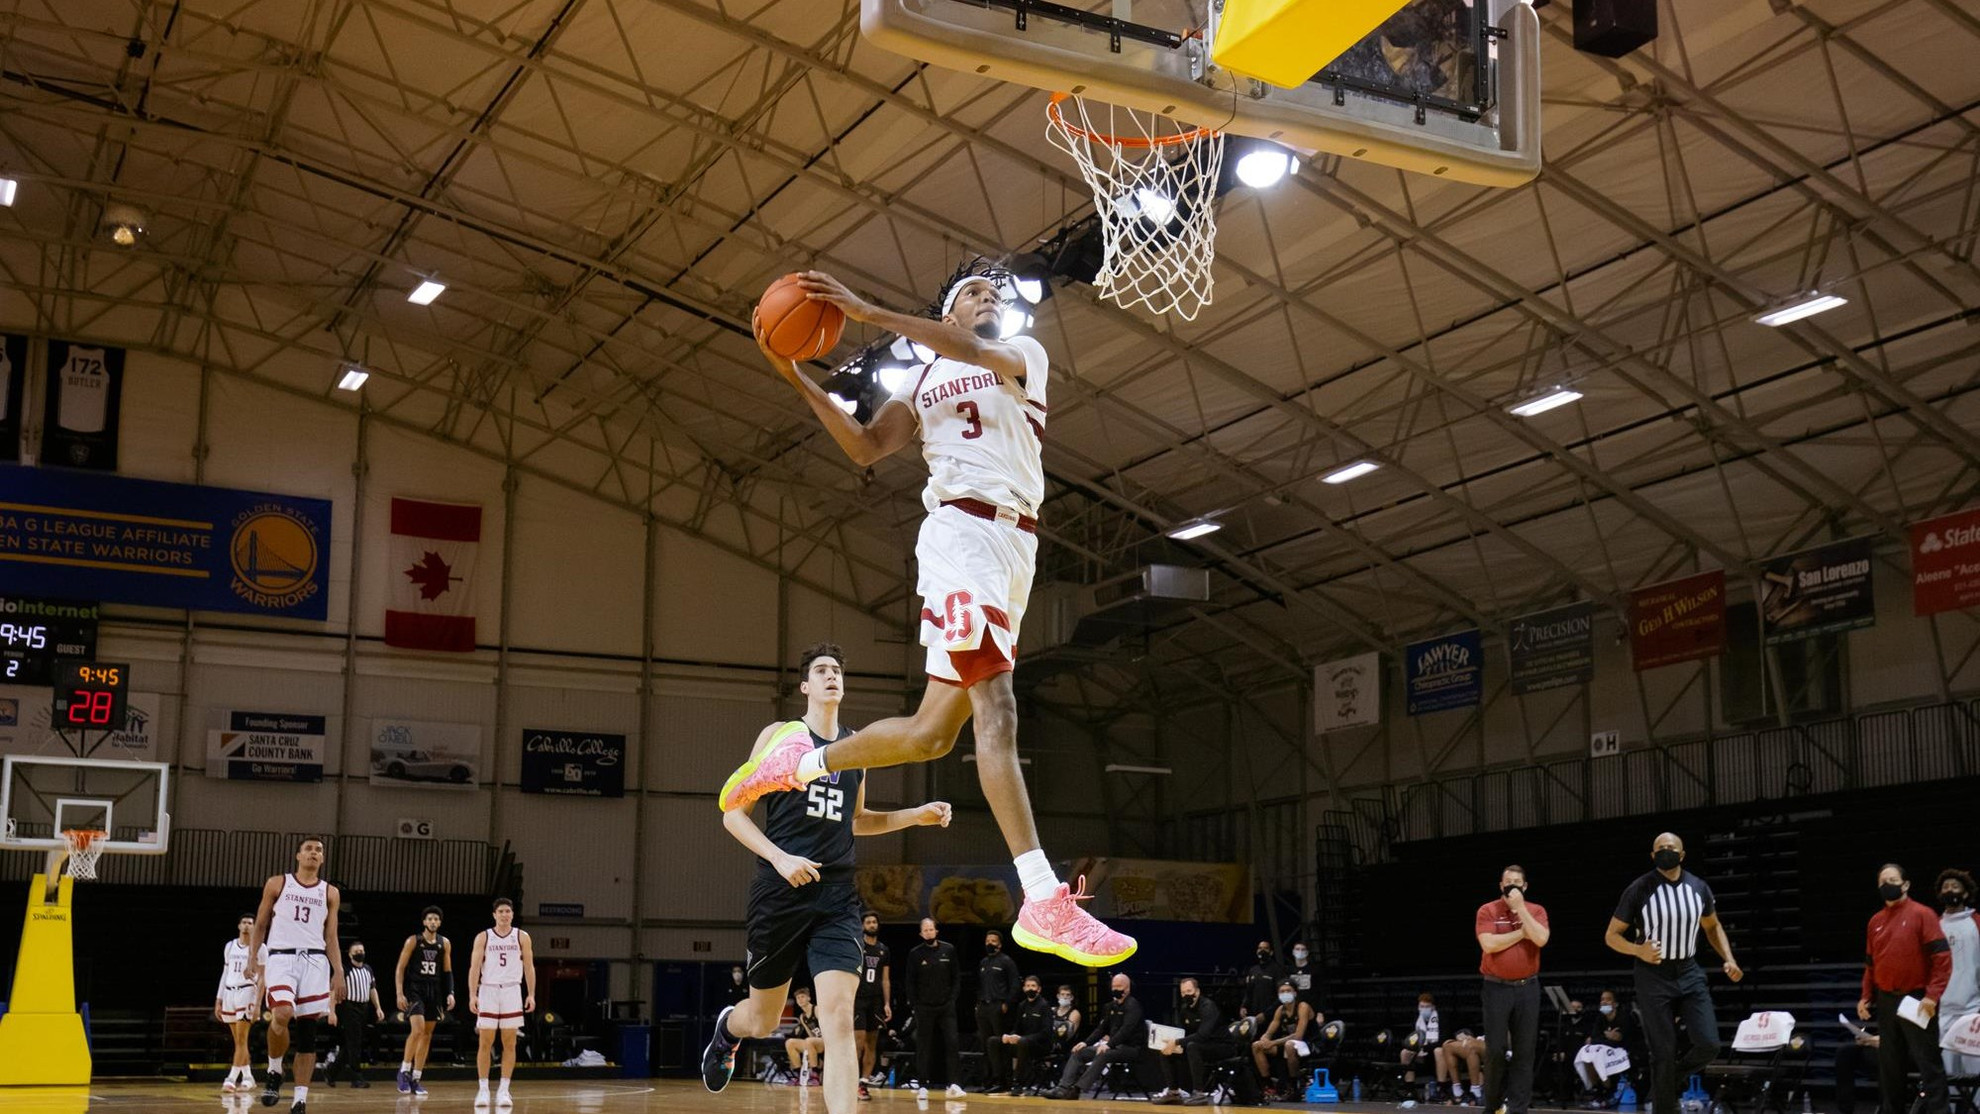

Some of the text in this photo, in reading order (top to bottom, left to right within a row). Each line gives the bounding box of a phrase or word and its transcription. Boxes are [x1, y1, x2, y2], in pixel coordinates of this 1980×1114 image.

[71, 357, 102, 375] 172
[67, 376, 102, 389] BUTLER
[921, 371, 1004, 408] STANFORD
[956, 400, 983, 440] 3
[231, 503, 320, 535] GOLDEN STATE
[24, 517, 38, 532] G
[43, 519, 117, 540] LEAGUE
[121, 527, 213, 549] AFFILIATE
[27, 536, 86, 555] STATE
[92, 543, 193, 565] WARRIORS
[1799, 570, 1822, 589] San
[1822, 559, 1870, 583] Lorenzo
[230, 576, 318, 608] WARRIORS
[1663, 605, 1675, 624] H
[1674, 585, 1718, 616] WILSON
[0, 623, 48, 649] 9:45
[1529, 615, 1591, 643] PRECISION
[56, 643, 87, 655] GUEST
[6, 660, 19, 677] 2
[1417, 644, 1470, 675] SAWYER
[79, 666, 120, 686] 9:45
[68, 690, 113, 724] 28
[248, 734, 300, 747] SANTA CRUZ
[1606, 735, 1617, 751] H
[248, 746, 314, 761] COUNTY BANK
[526, 734, 621, 767] Cabrillo College
[806, 784, 844, 822] 52
[417, 823, 430, 836] G
[285, 894, 324, 907] STANFORD
[32, 913, 67, 922] SPALDING
[294, 905, 311, 924] 13
[488, 944, 518, 953] STANFORD
[233, 961, 243, 974] 11
[420, 961, 438, 976] 33
[499, 952, 508, 968] 5
[866, 968, 876, 983] 0
